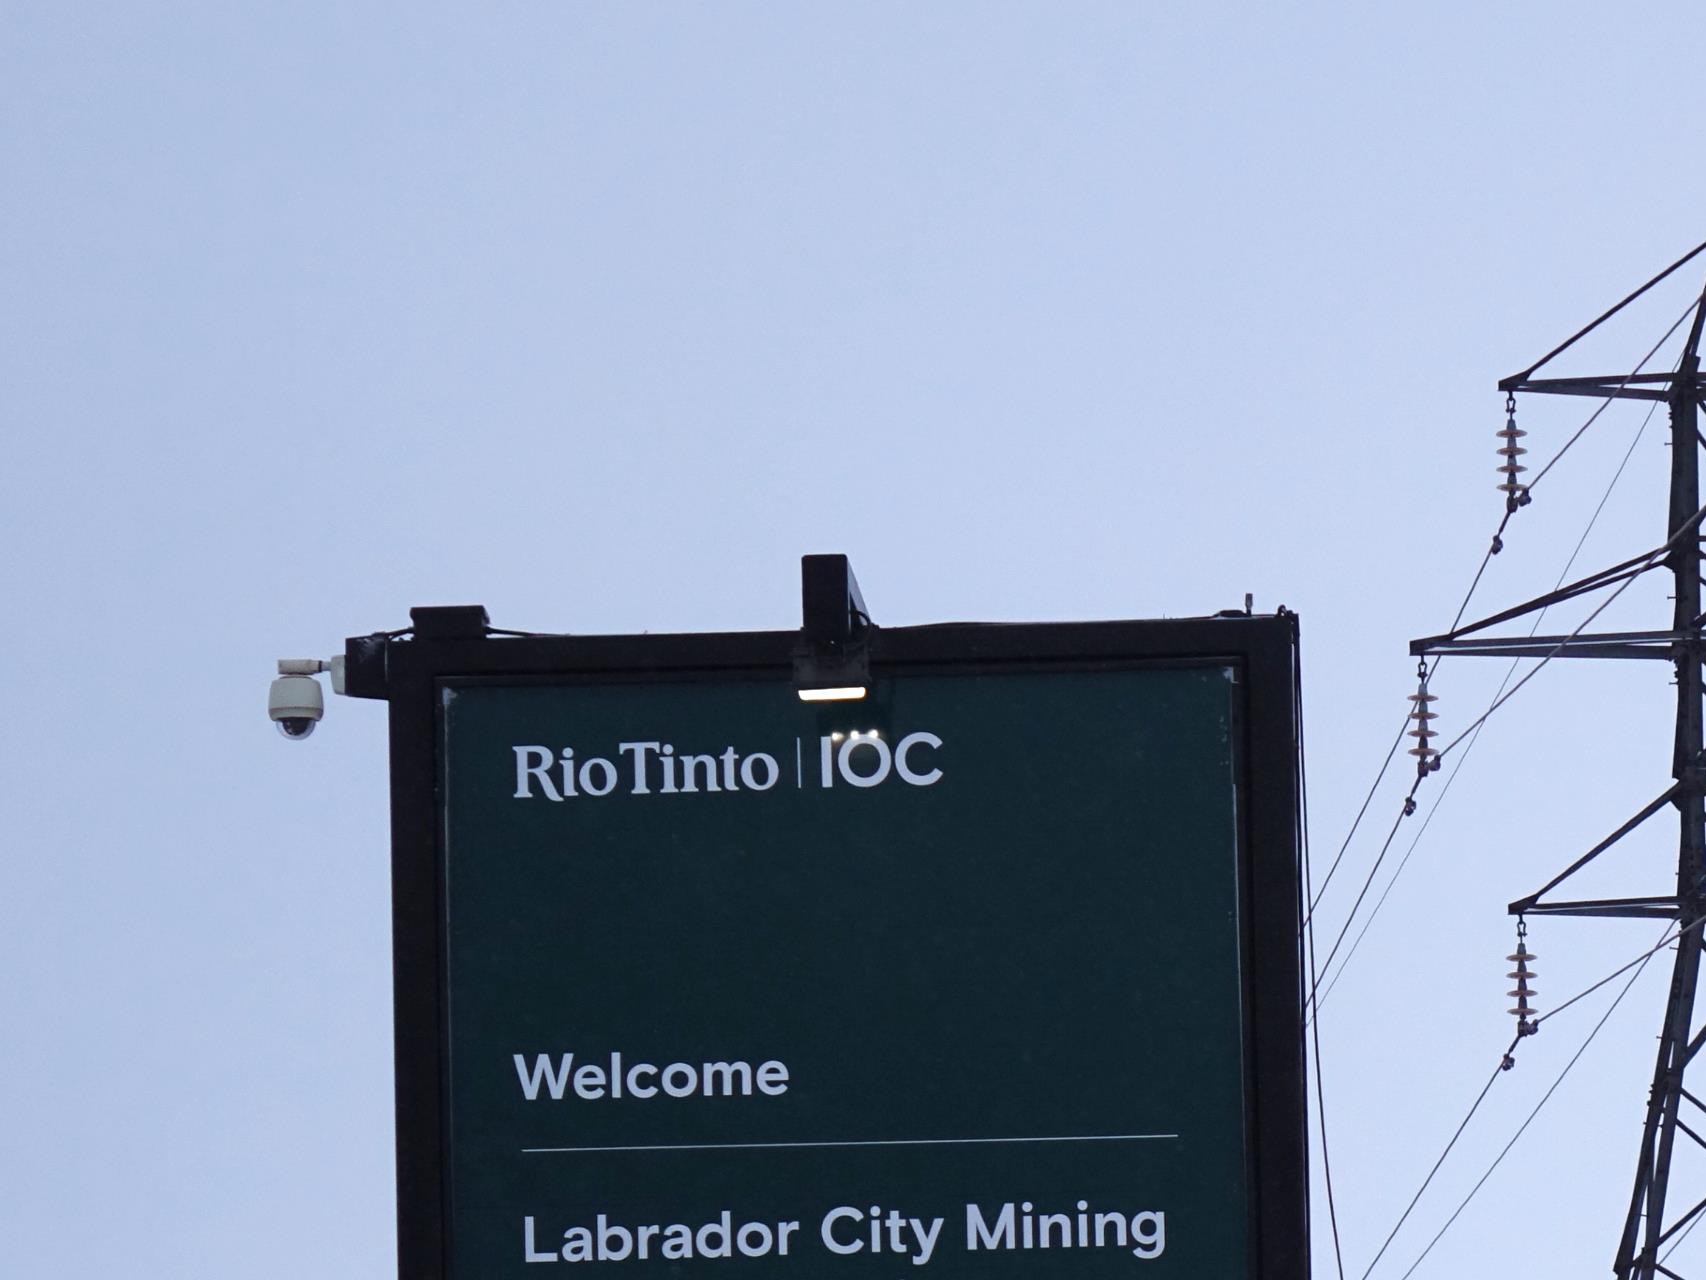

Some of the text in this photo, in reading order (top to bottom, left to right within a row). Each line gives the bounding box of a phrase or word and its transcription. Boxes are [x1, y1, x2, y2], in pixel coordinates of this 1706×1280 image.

[820, 731, 943, 788] IOC
[513, 1051, 789, 1101] Welcome
[524, 1200, 1166, 1266] Labrador City Mining
